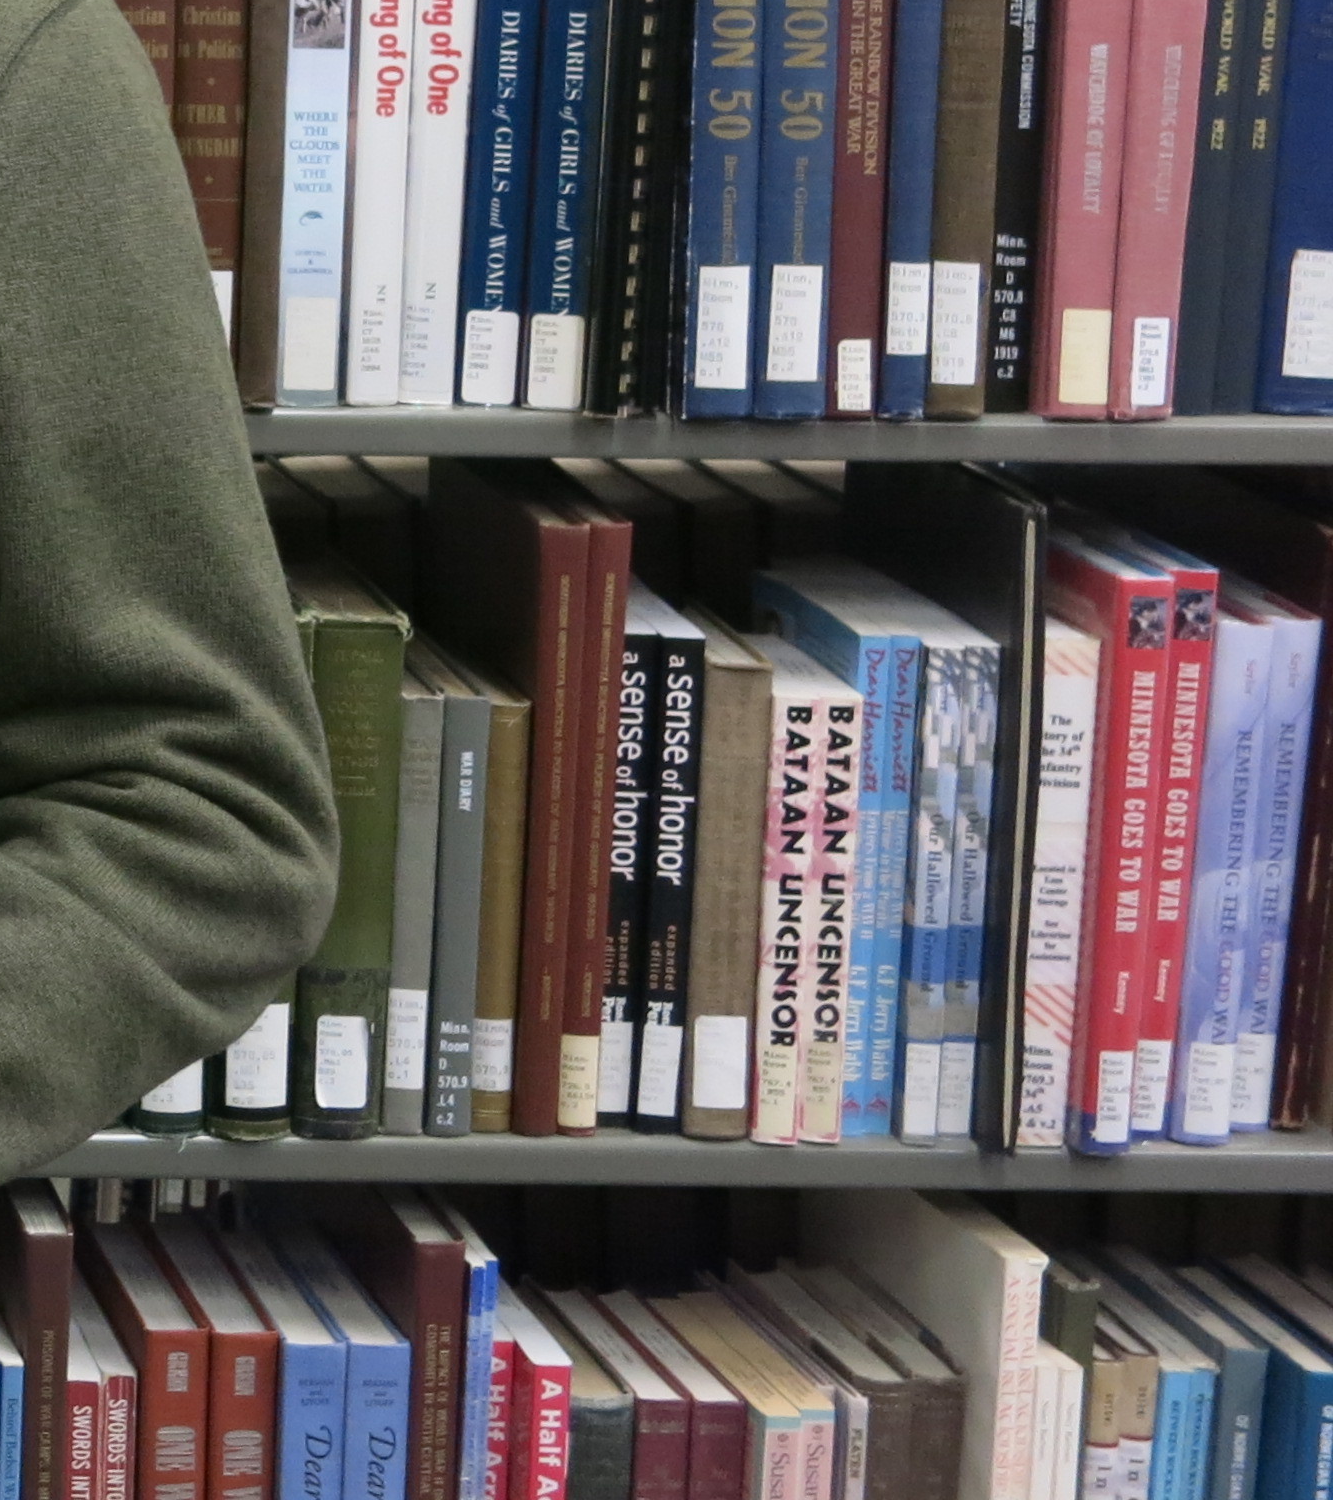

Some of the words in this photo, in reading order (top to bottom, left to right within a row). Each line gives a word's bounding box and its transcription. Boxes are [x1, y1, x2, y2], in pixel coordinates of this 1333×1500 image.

[378, 34, 407, 59] of
[497, 10, 521, 99] DIARIES
[375, 65, 404, 117] One
[492, 105, 510, 121] of
[709, 88, 753, 140] 50
[492, 126, 513, 193] GIRLS
[489, 197, 505, 227] and
[668, 654, 685, 668] a
[663, 673, 693, 764] sense
[1124, 671, 1155, 789] MINNESOTA
[662, 770, 682, 790] of
[780, 705, 813, 855] BATAAN
[656, 795, 694, 885] honor
[1120, 799, 1147, 848] GOES
[1118, 857, 1142, 881] TO
[1114, 889, 1141, 933] WAR
[70, 1405, 93, 1469] SWORDS
